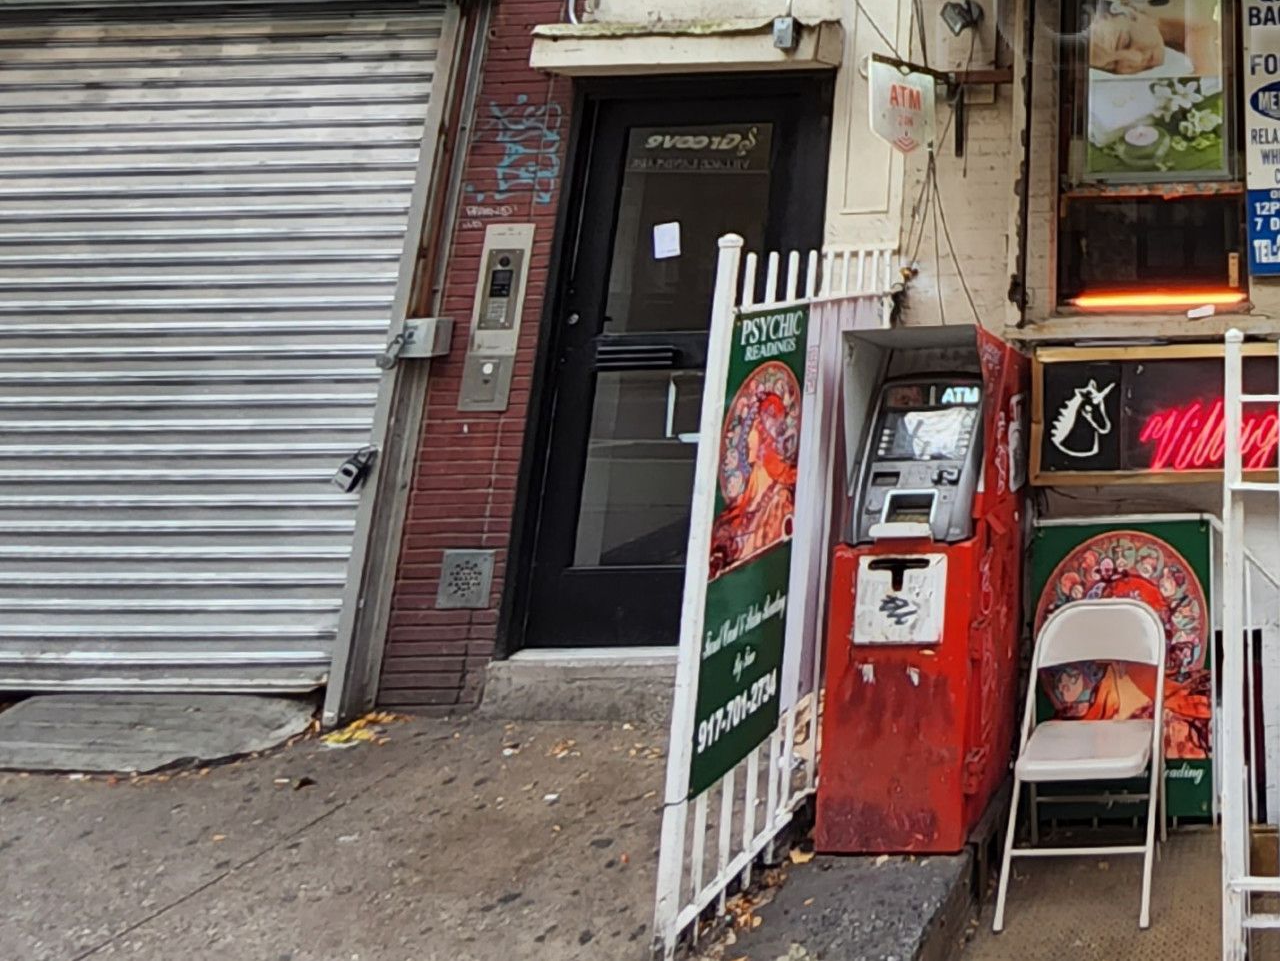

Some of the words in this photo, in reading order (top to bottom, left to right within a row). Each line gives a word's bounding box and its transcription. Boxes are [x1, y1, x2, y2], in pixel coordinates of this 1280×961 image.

[890, 84, 922, 112] ATM
[1254, 217, 1263, 231] 7
[741, 310, 803, 346] PSYCHIC
[744, 337, 796, 361] READINGS
[941, 386, 979, 404] ATM
[697, 667, 777, 754] 917-701-2734
